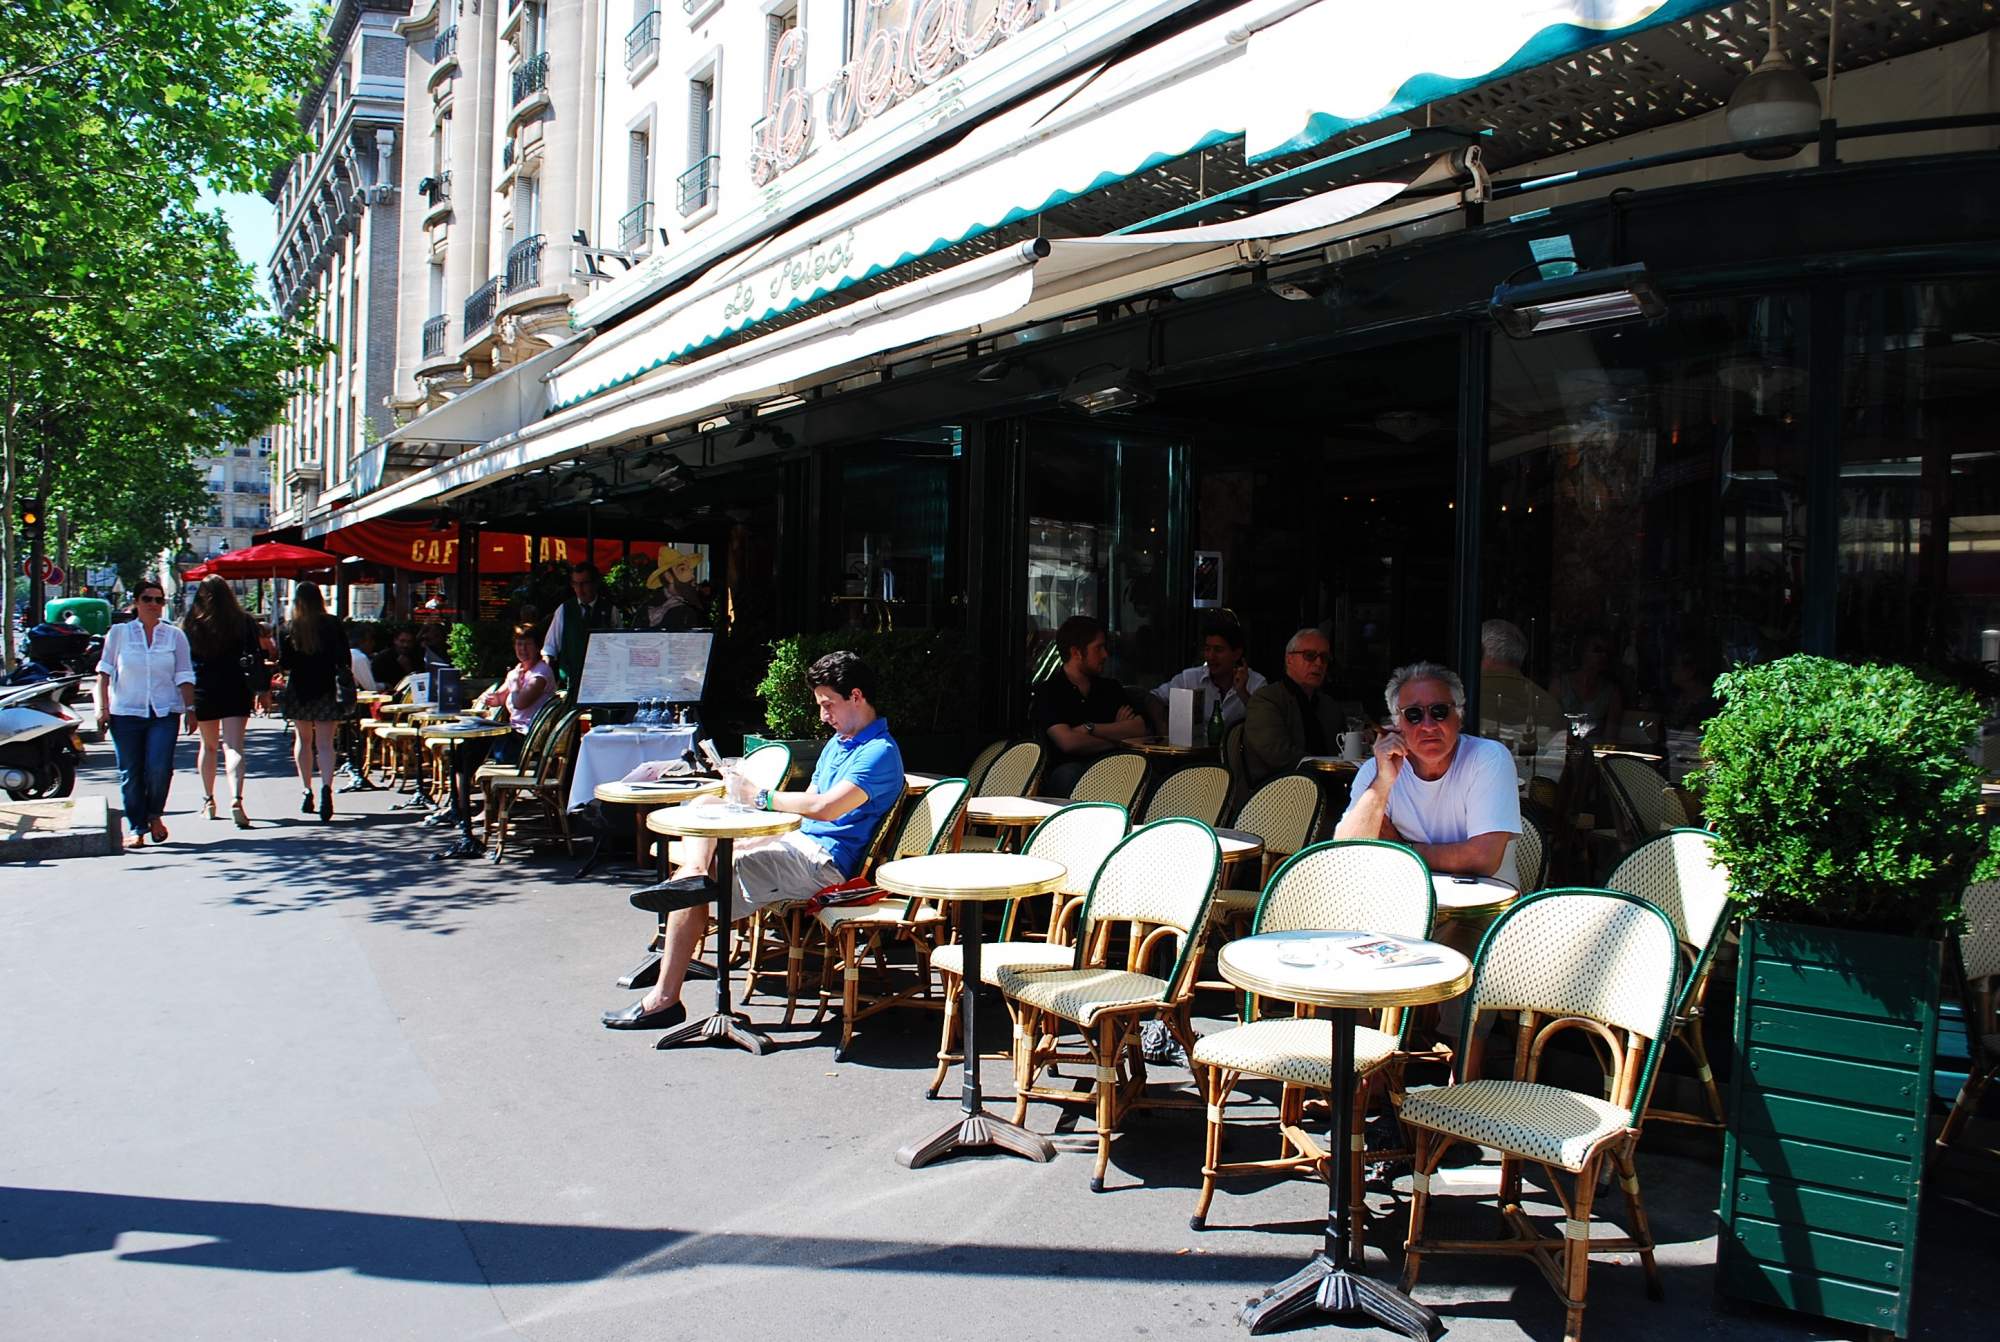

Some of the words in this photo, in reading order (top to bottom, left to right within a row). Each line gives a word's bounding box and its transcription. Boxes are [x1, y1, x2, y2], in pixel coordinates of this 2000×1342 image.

[747, 27, 815, 187] Le
[723, 281, 755, 320] Le
[769, 229, 856, 299] Select
[410, 537, 475, 565] CAF
